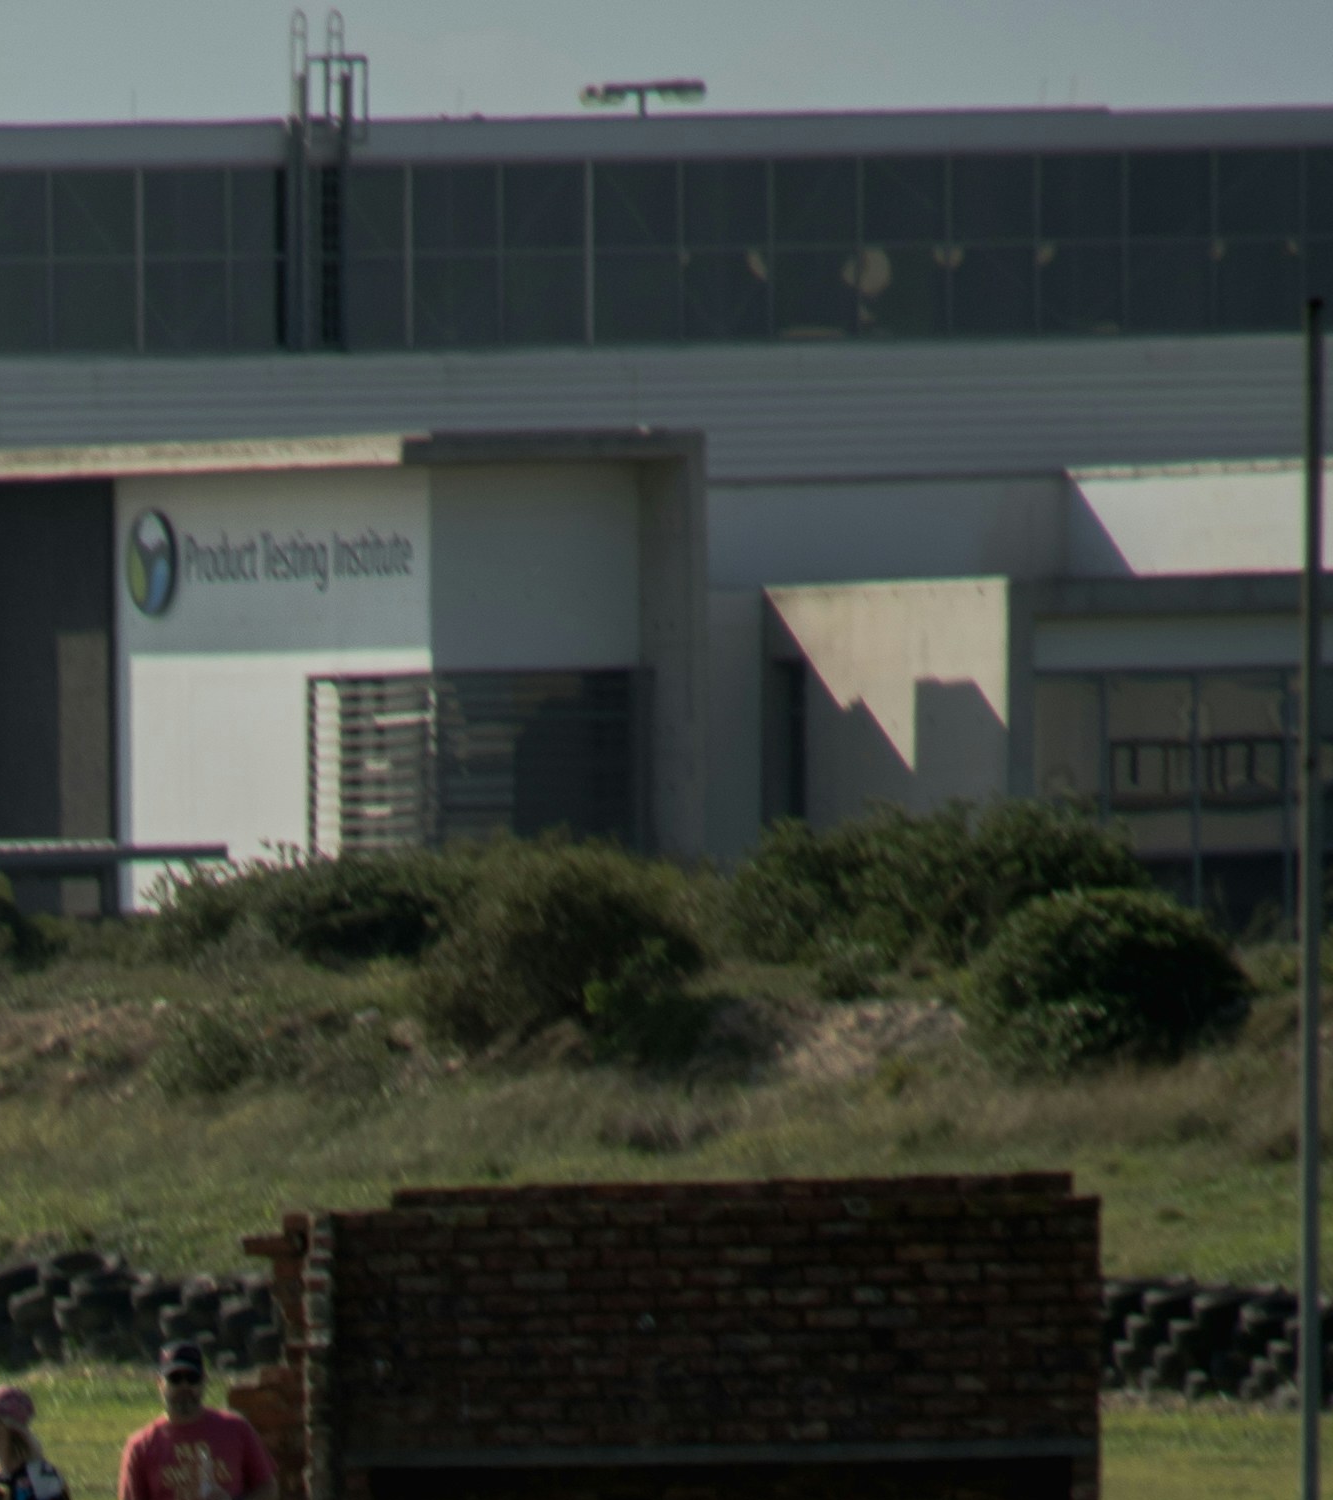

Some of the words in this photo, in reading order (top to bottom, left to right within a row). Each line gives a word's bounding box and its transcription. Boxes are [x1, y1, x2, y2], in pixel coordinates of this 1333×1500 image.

[184, 530, 258, 582] Product
[260, 529, 329, 592] Testing
[333, 527, 414, 577] Institute
